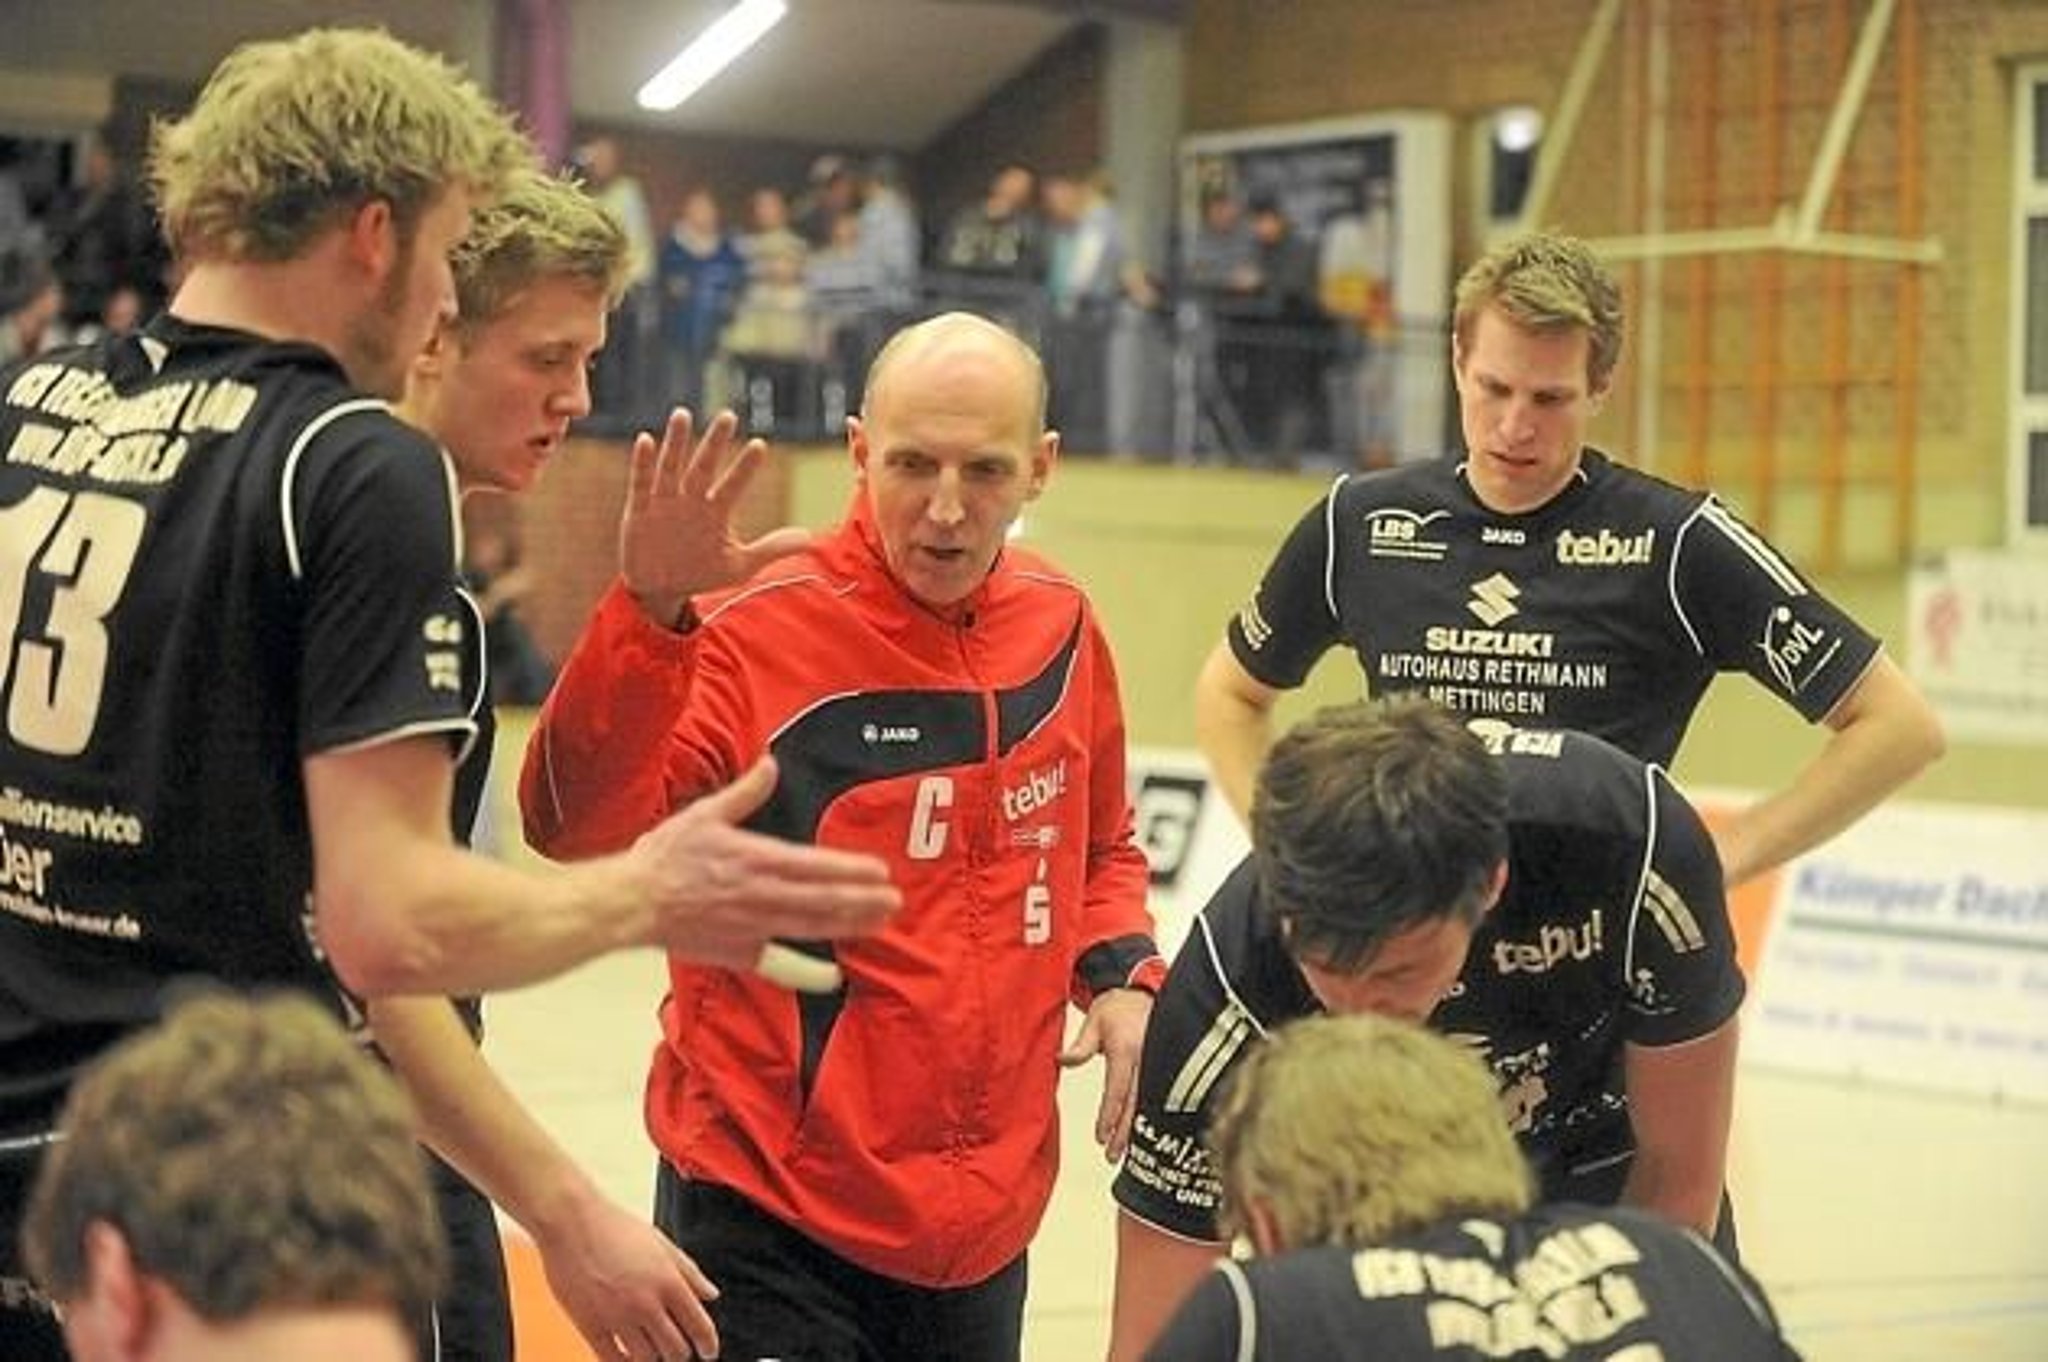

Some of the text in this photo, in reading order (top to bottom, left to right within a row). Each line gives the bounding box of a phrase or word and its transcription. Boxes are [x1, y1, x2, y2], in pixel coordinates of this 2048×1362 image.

[1371, 518, 1416, 540] LBS
[1556, 528, 1655, 564] tebu!
[1425, 627, 1554, 657] SUZUKI
[1780, 621, 1825, 666] DVL
[1379, 653, 1607, 687] AUTOHAUS RETHMANN
[1002, 759, 1067, 821] tebu!
[906, 776, 954, 860] C
[1492, 909, 1603, 975] tebu!
